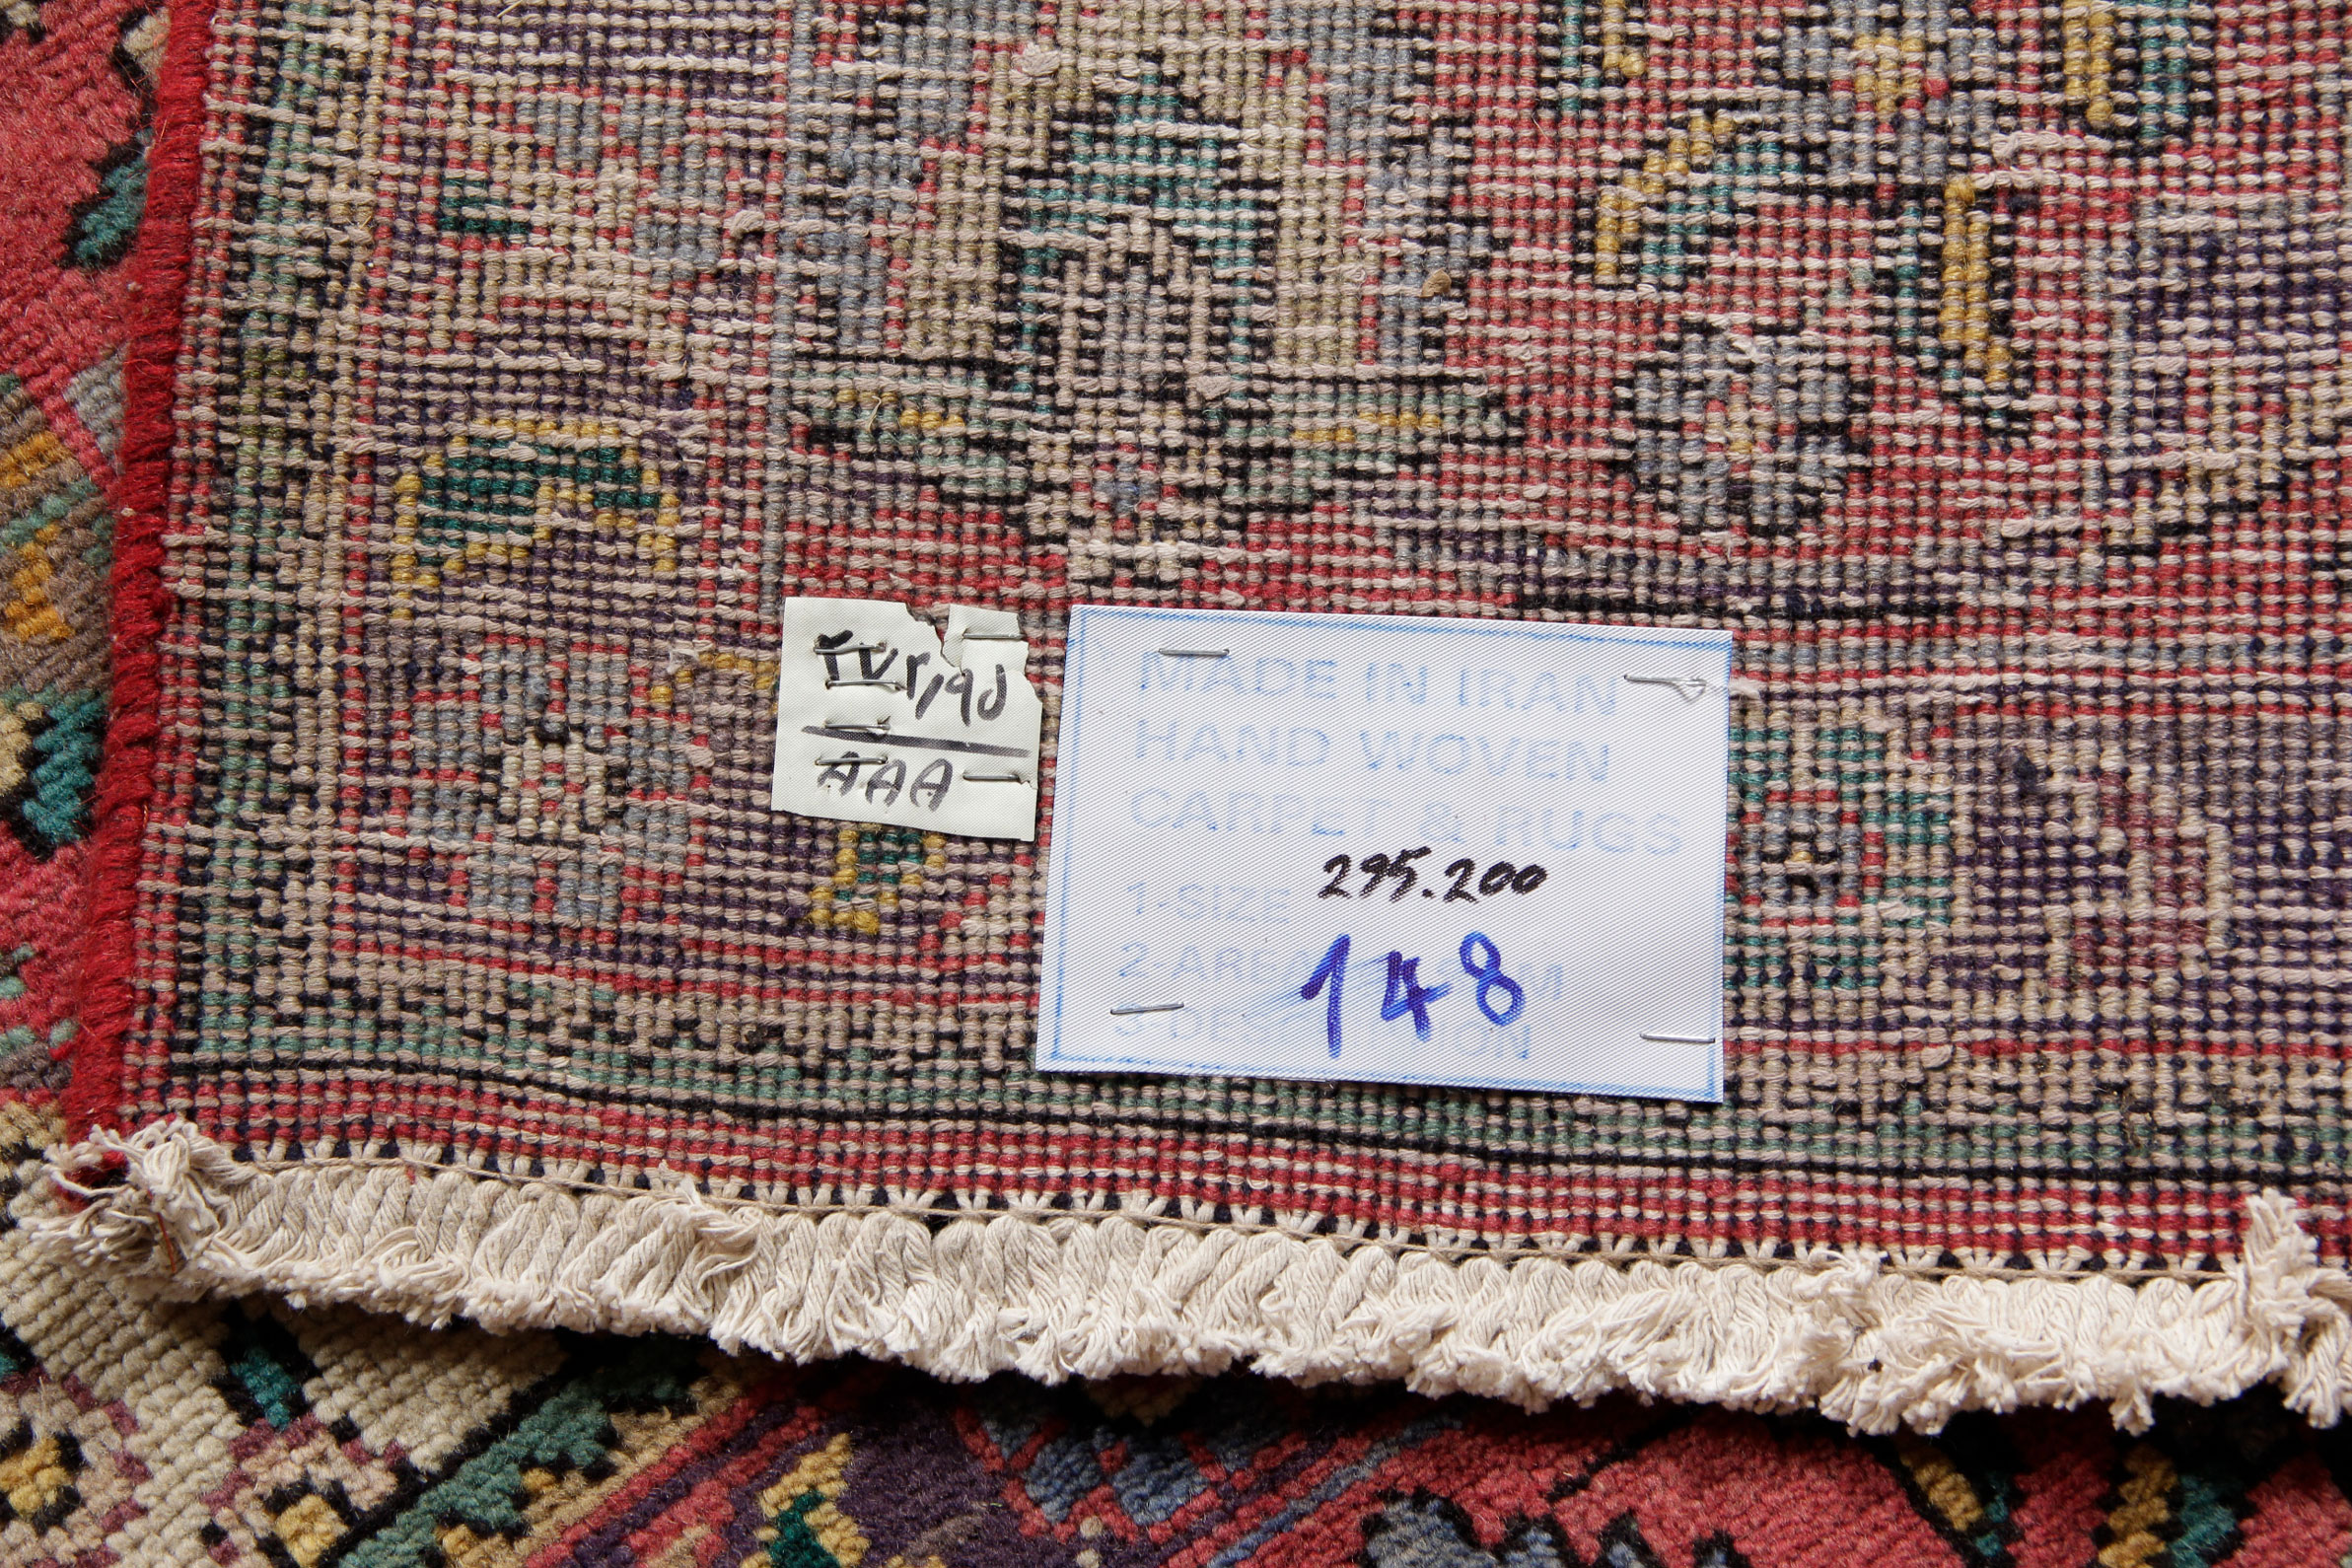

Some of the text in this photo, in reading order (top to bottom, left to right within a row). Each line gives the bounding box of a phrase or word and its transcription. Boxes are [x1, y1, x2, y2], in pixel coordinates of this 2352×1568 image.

[1140, 650, 1618, 717] MADE IN IRAN
[1134, 719, 1610, 782] HAND WOVEN
[1130, 788, 1683, 856] CARPET & RUGS
[1301, 930, 1527, 1060] 148
